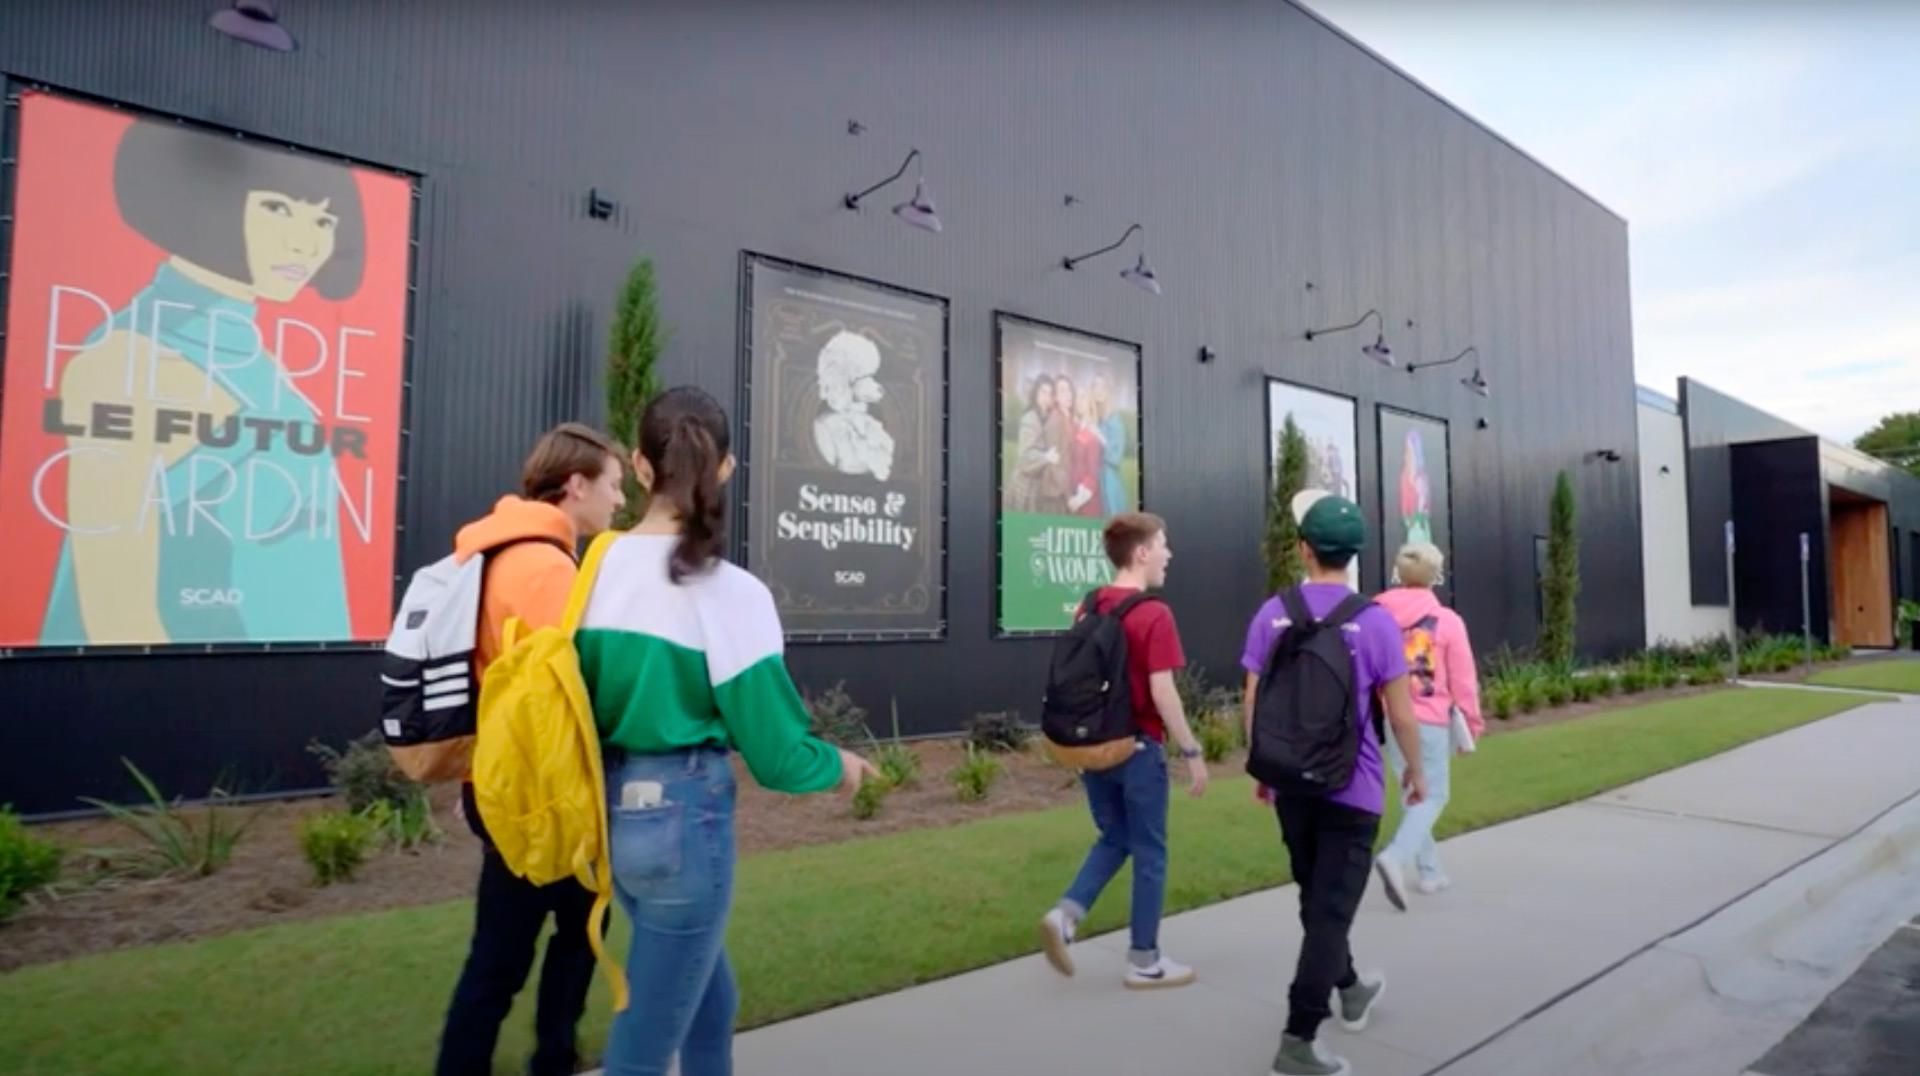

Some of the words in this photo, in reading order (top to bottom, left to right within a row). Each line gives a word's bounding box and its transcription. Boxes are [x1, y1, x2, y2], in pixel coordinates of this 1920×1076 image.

[45, 285, 376, 421] PIERRE
[42, 399, 135, 441] LE
[153, 408, 368, 459] FUTUR
[32, 446, 373, 544] CARDIN
[799, 484, 877, 515] Sense
[884, 491, 905, 517] &
[777, 511, 916, 550] Sensibility
[1047, 527, 1105, 555] LITTLE
[834, 570, 865, 583] SCAD
[1047, 555, 1111, 584] WOMEN
[180, 588, 244, 605] SCAD
